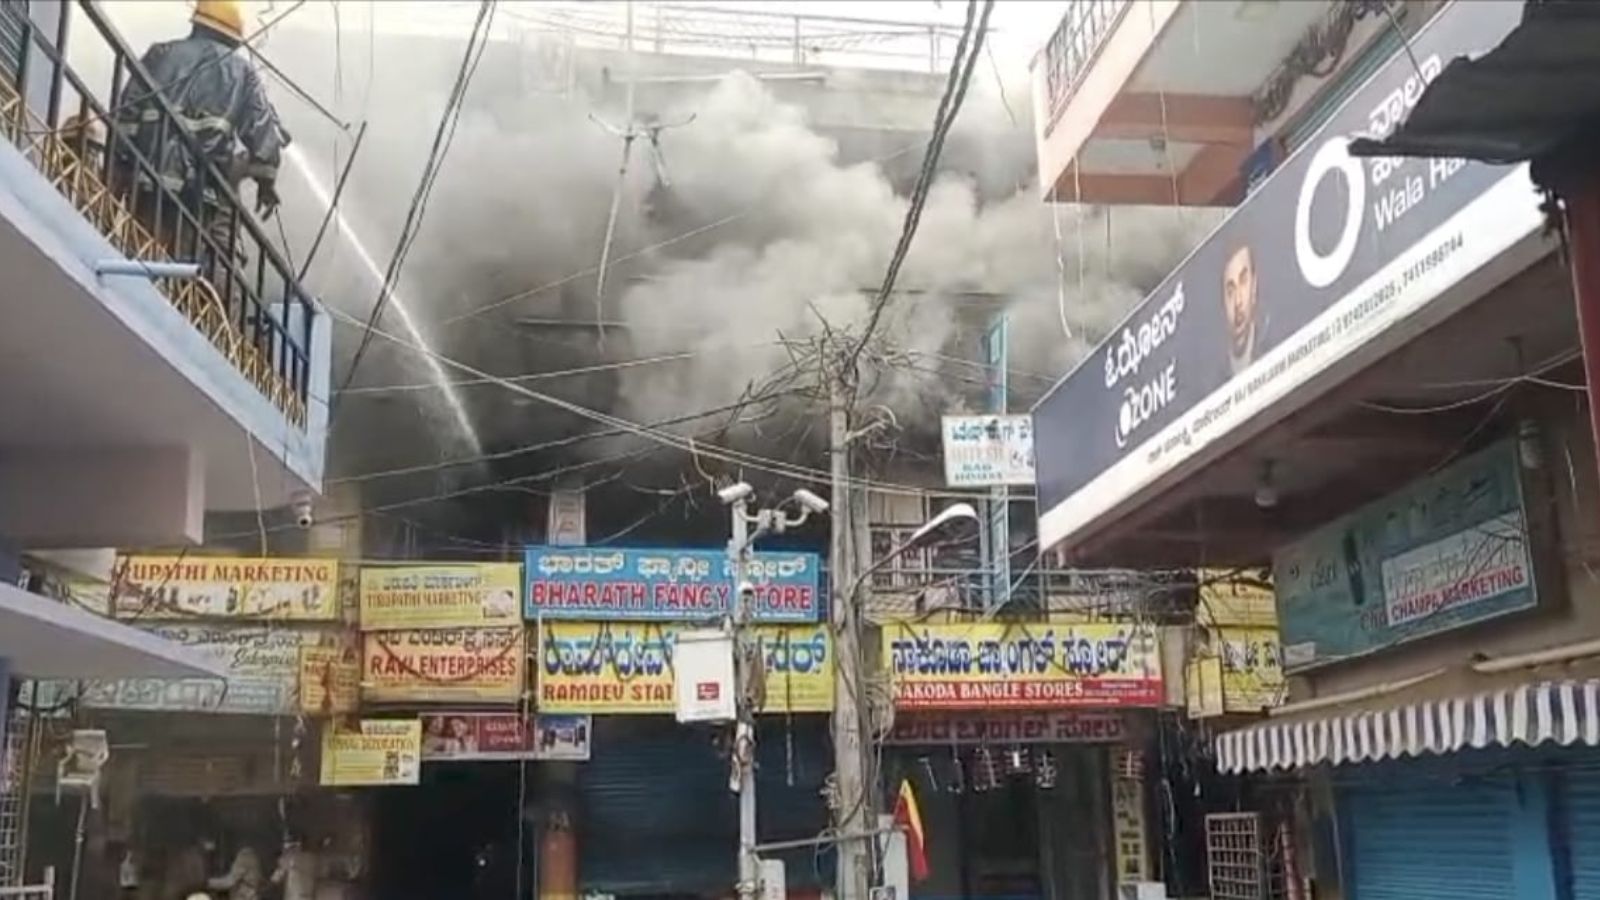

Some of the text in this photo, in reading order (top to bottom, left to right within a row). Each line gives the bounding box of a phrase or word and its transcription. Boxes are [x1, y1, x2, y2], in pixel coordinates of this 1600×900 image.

[1374, 176, 1425, 231] Wala
[1429, 157, 1466, 189] Ha
[133, 563, 329, 582] UPATHI MARKETING
[530, 580, 814, 612] BHARATH FANCY TORE
[1391, 565, 1524, 623] CHAMPA MARKETING
[370, 655, 517, 677] RAVI ENTERPRISES
[543, 682, 673, 701] RAMDEV STAT
[892, 681, 957, 699] NAKODA
[960, 681, 1020, 699] BANGLE
[1023, 681, 1083, 698] STORES
